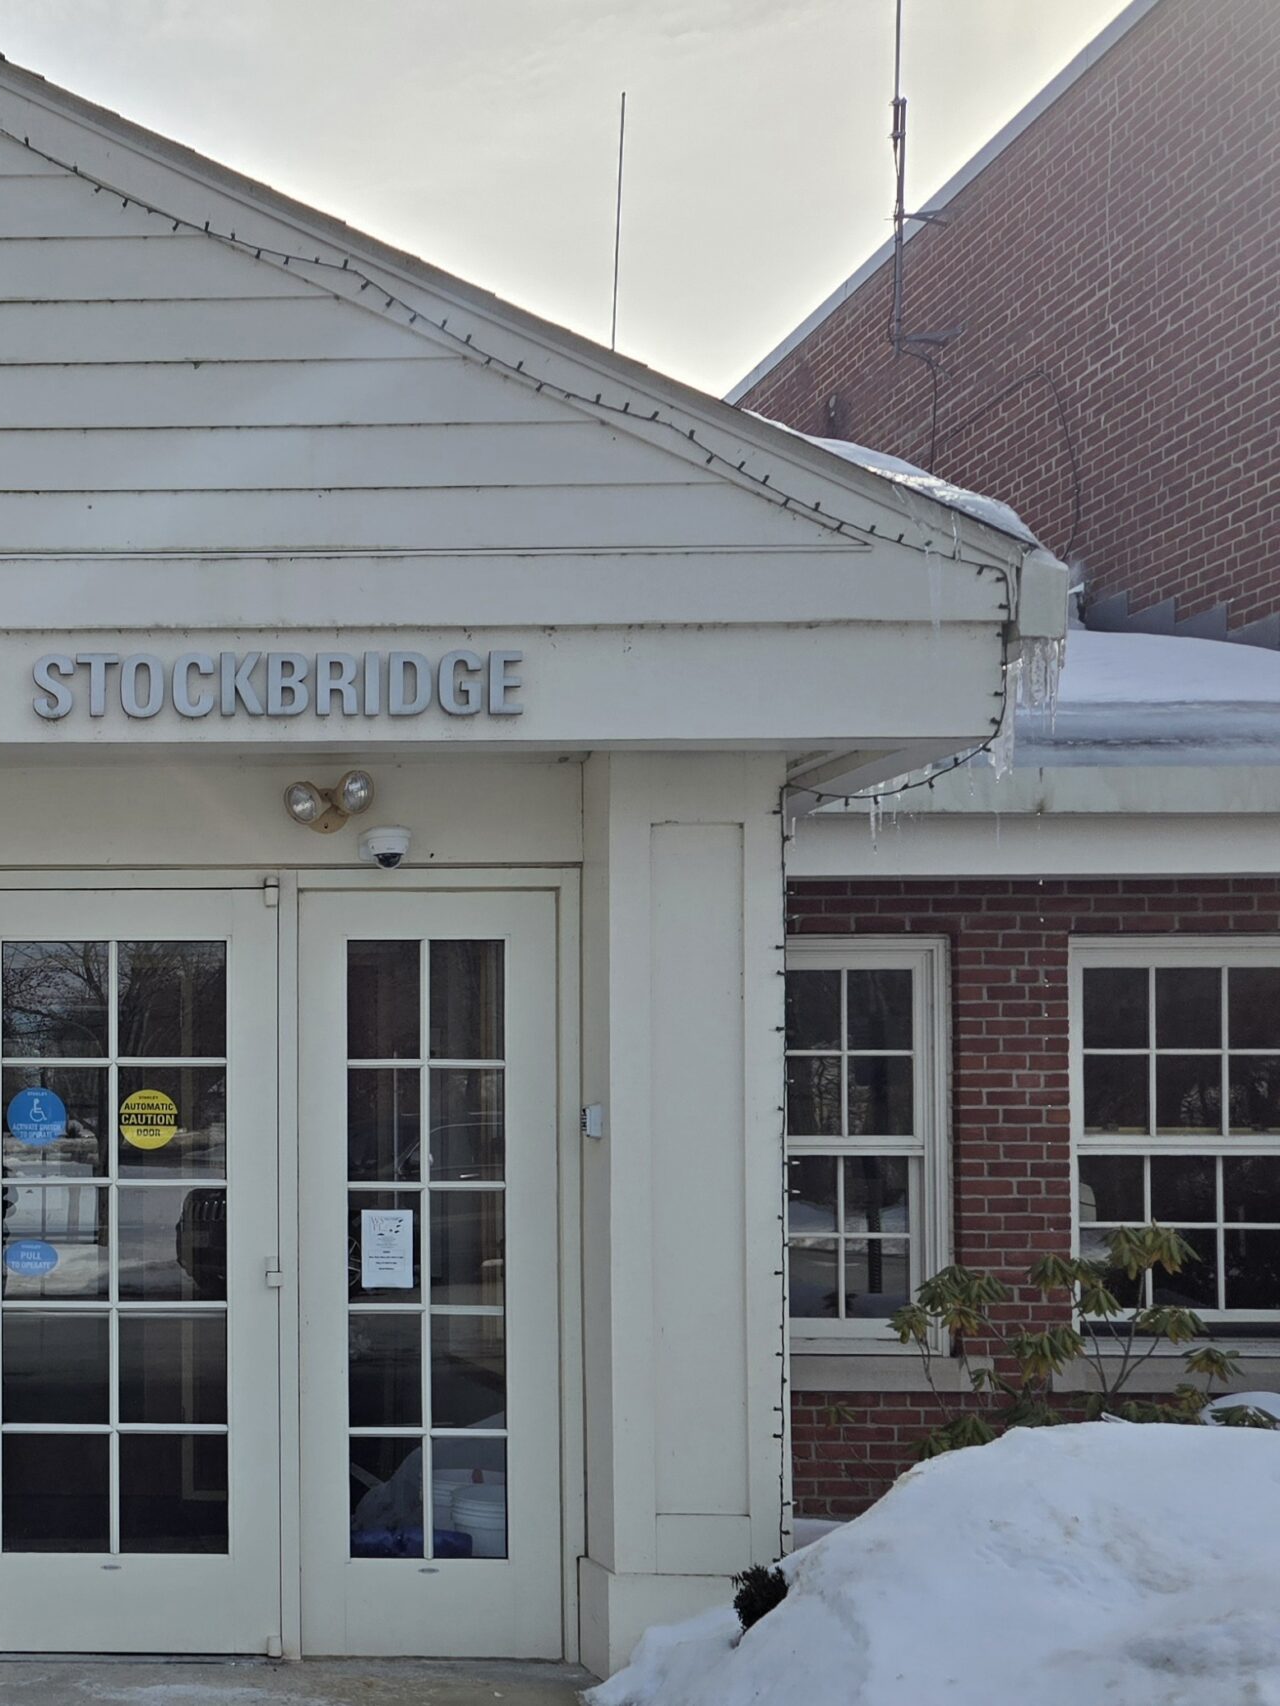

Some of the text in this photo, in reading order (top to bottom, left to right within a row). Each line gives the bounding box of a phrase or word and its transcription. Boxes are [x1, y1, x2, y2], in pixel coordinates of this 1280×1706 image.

[31, 650, 523, 719] STOCKBRIDGE
[124, 1102, 174, 1111] AUTOMATIC
[121, 1114, 175, 1125] CAUTION
[12, 1122, 38, 1130] ACTIVATE
[136, 1128, 161, 1137] DOOR
[20, 1251, 41, 1260] PULL
[11, 1261, 50, 1269] TO OPERATE
